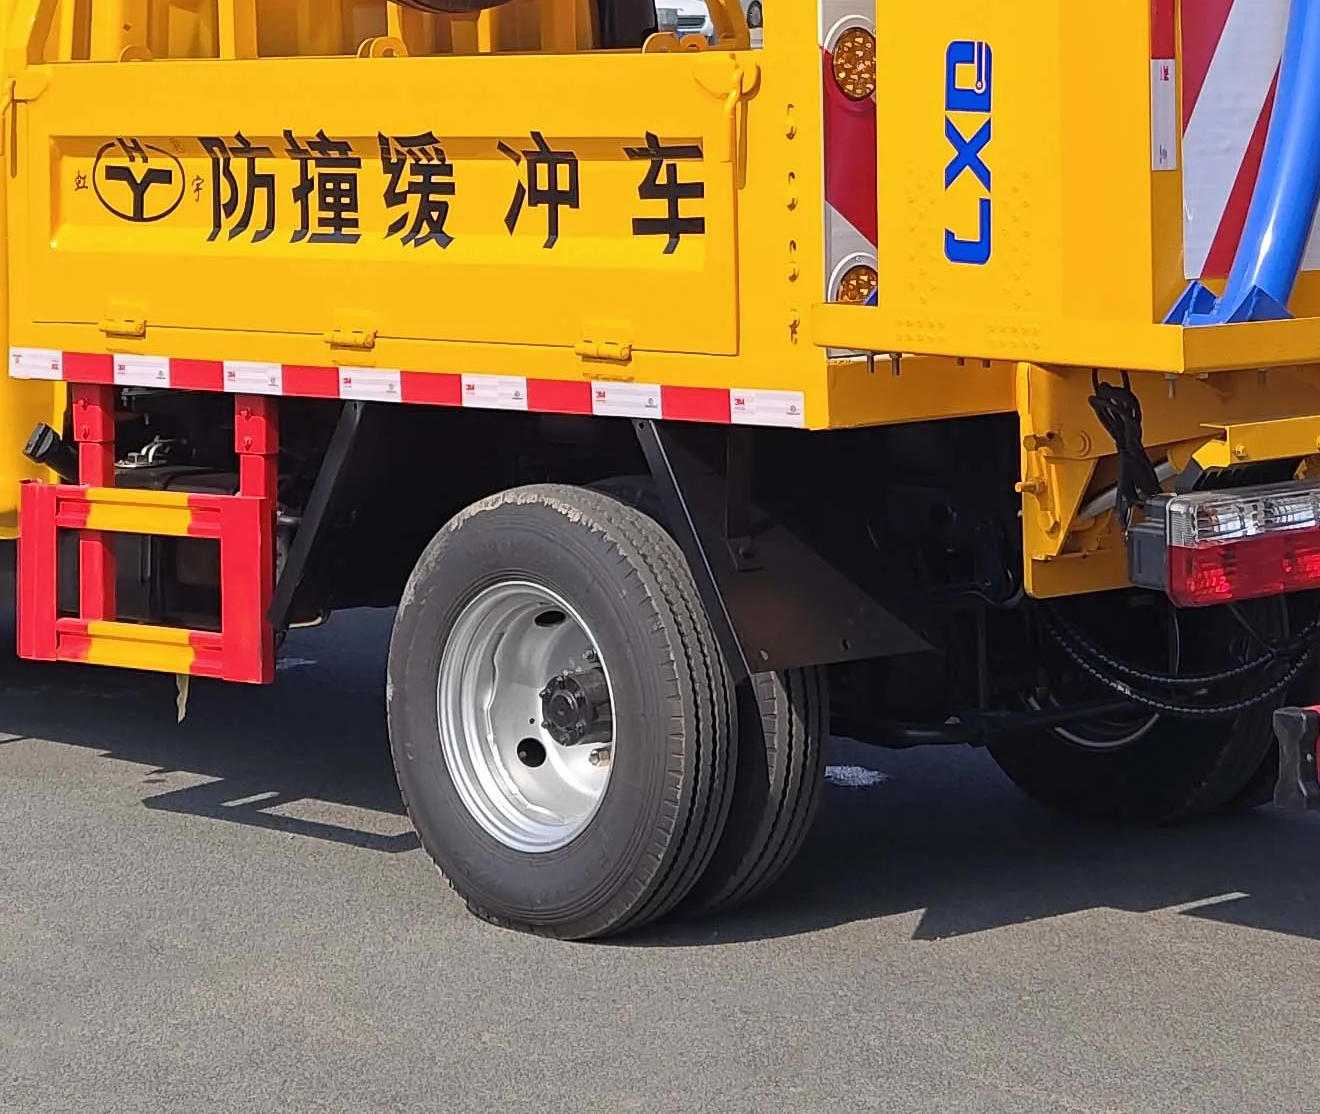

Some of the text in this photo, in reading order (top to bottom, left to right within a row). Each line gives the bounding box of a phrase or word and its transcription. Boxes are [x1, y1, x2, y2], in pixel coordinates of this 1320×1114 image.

[197, 129, 707, 255] 防撞缓冲车
